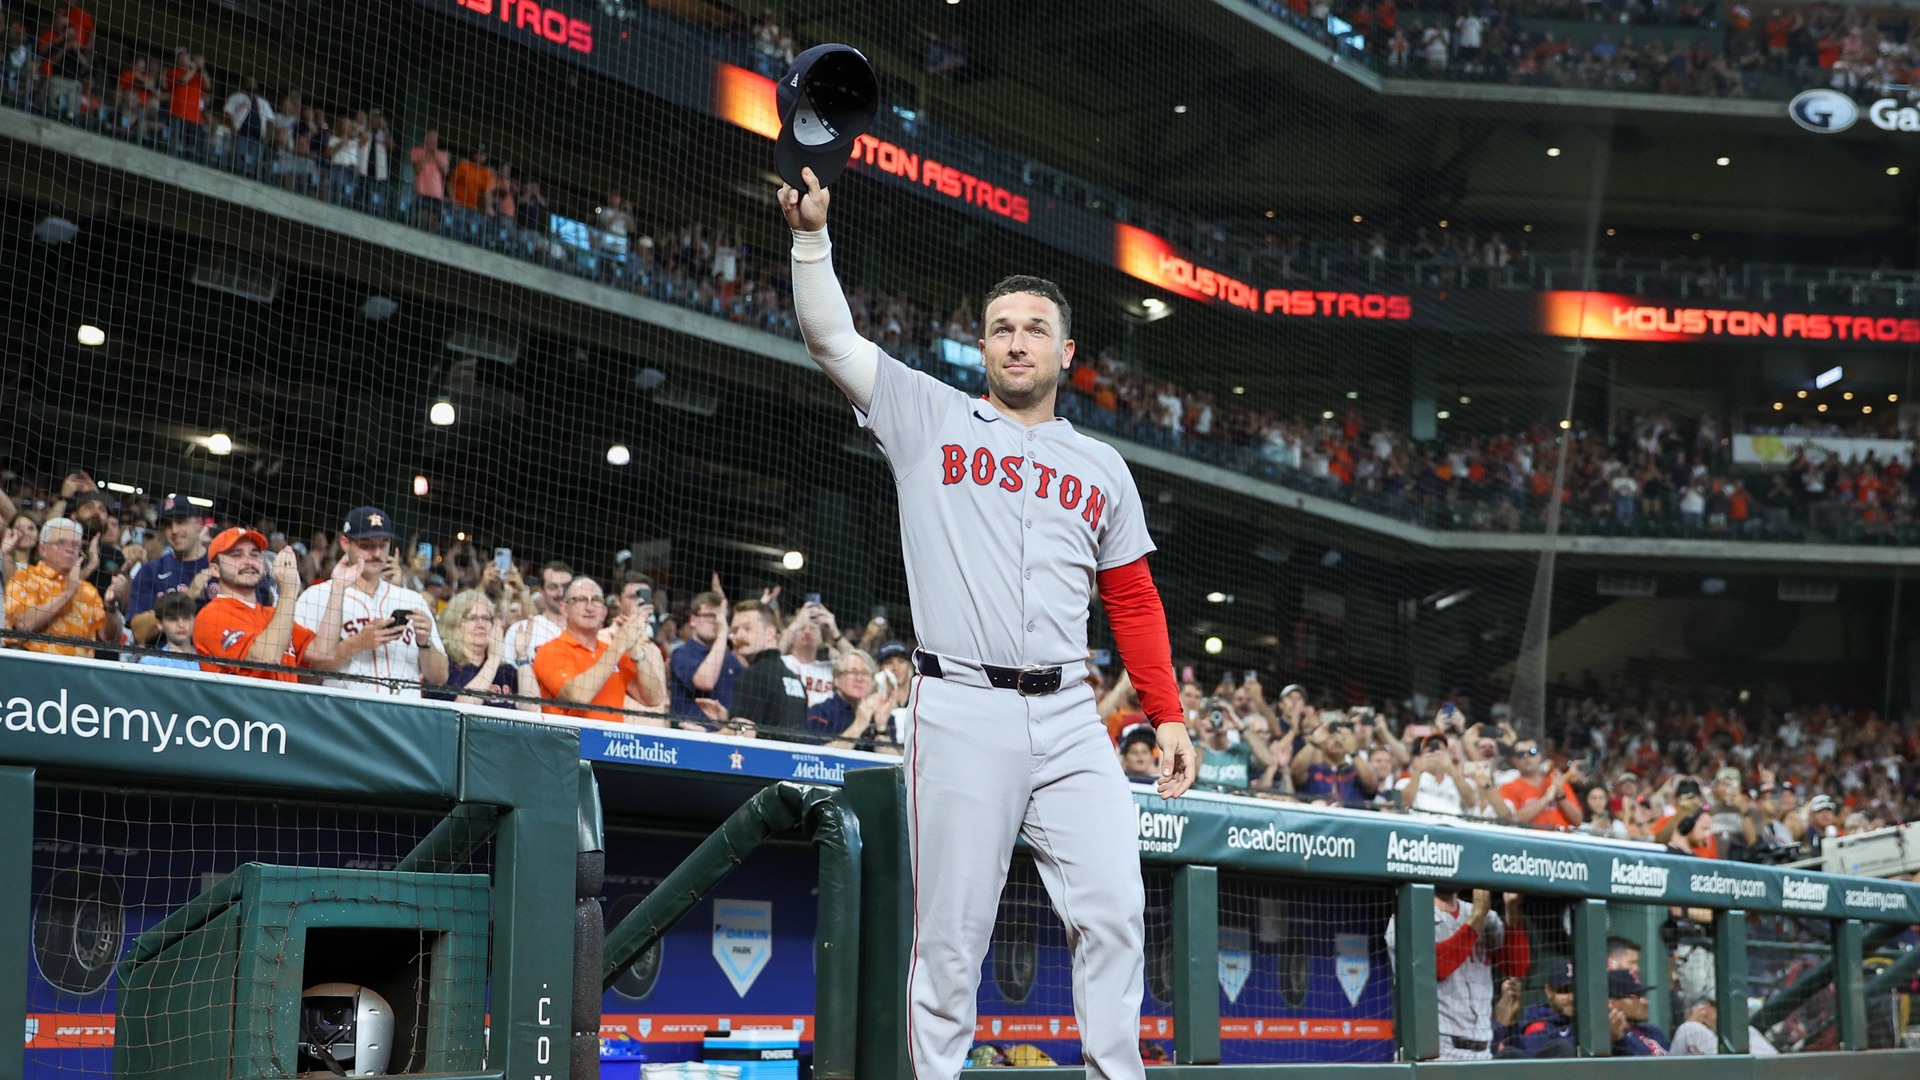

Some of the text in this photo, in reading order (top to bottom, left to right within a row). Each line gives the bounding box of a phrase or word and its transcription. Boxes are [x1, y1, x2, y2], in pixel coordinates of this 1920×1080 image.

[1869, 98, 1920, 132] Ga
[922, 159, 1030, 224] ASTROS
[1159, 253, 1412, 320] HOUSTON ASTROS
[1612, 305, 1920, 342] HOUSTON ASTROS
[941, 444, 1106, 531] BOSTON
[0, 688, 287, 755] ademy.com
[603, 731, 635, 741] HOUSTON
[603, 738, 679, 765] Methodist
[792, 760, 845, 782] Methodi
[1227, 822, 1356, 860] academy.com
[1386, 830, 1462, 874] Academy
[1492, 849, 1589, 882] academy.com
[1610, 857, 1669, 897] Academy
[1690, 870, 1767, 900] academy.com
[1782, 875, 1830, 911] Academy
[1845, 886, 1907, 912] academy.com
[533, 983, 553, 1080] .CO
